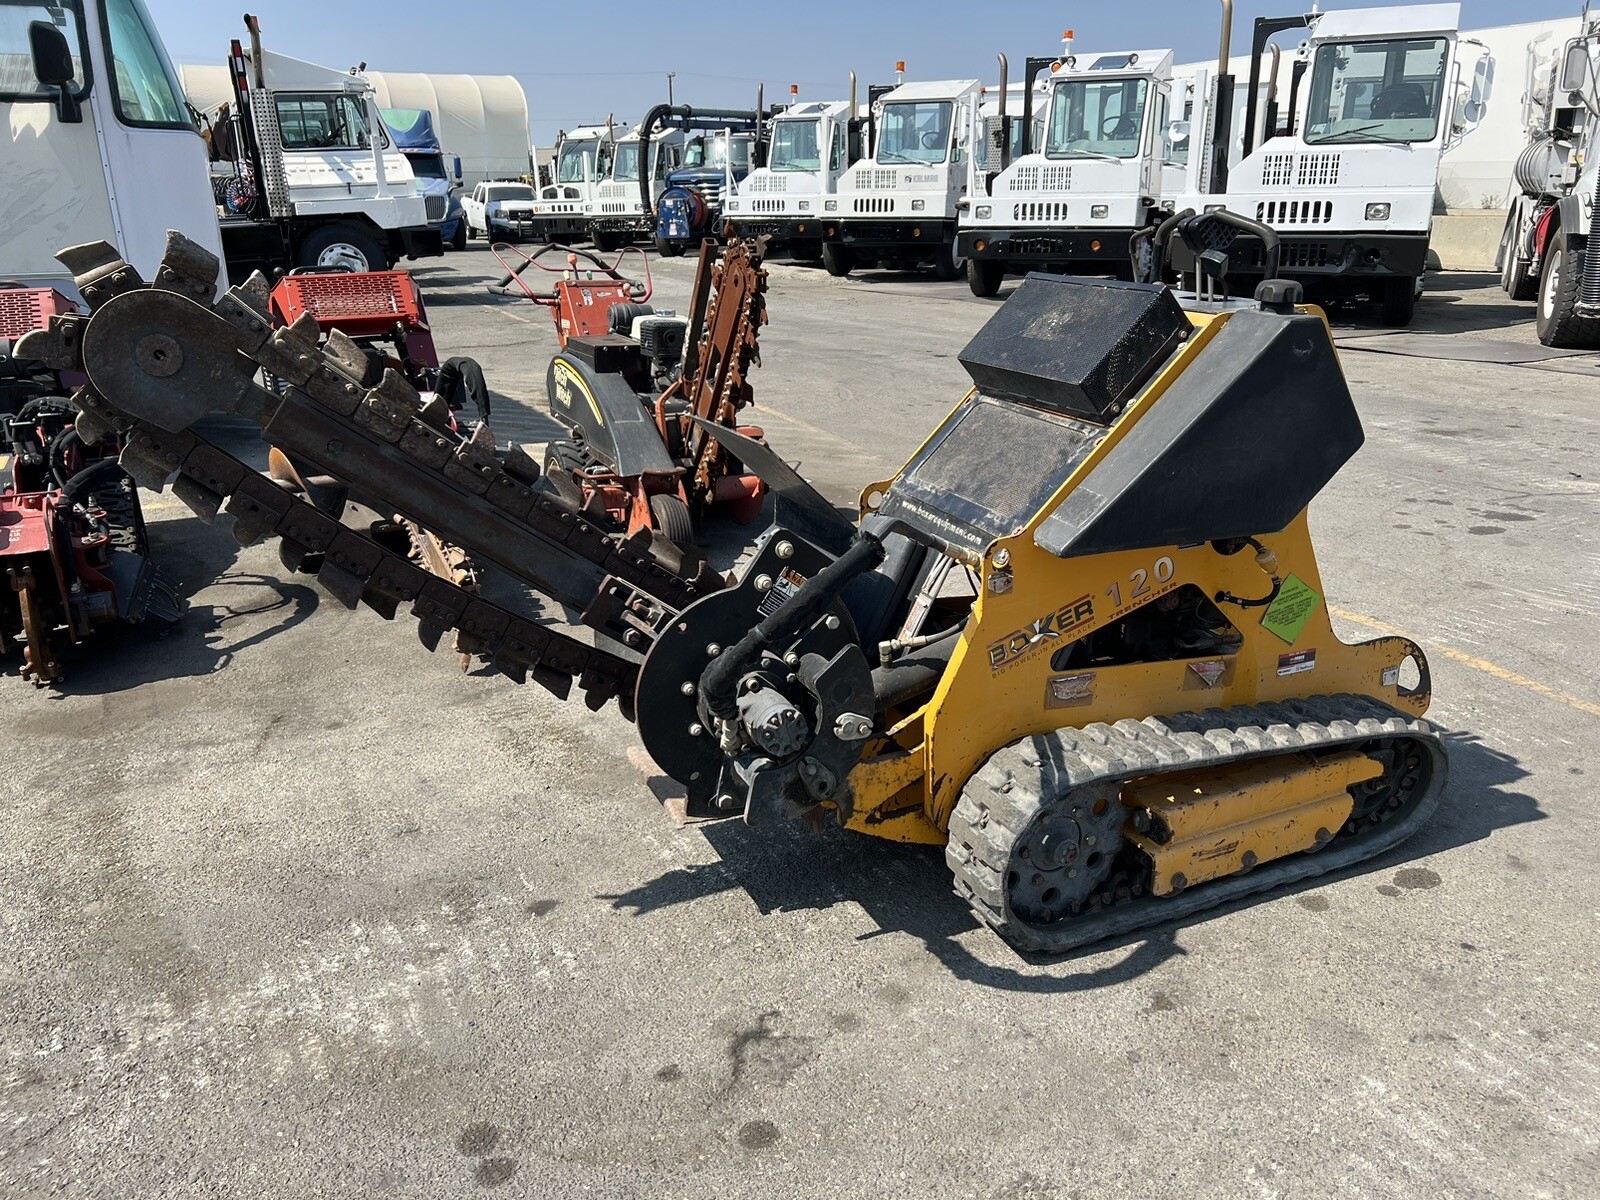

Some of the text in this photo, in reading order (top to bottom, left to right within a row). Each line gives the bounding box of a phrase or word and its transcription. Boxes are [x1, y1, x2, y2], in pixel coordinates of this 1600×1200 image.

[902, 500, 982, 546] www.boxerequipment.com
[1105, 556, 1175, 608] 120
[1108, 582, 1177, 619] TRENCHER
[989, 599, 1094, 667] BOXER
[991, 668, 1006, 679] BIG
[1051, 638, 1064, 648] ALL
[1067, 620, 1097, 639] PLACES
